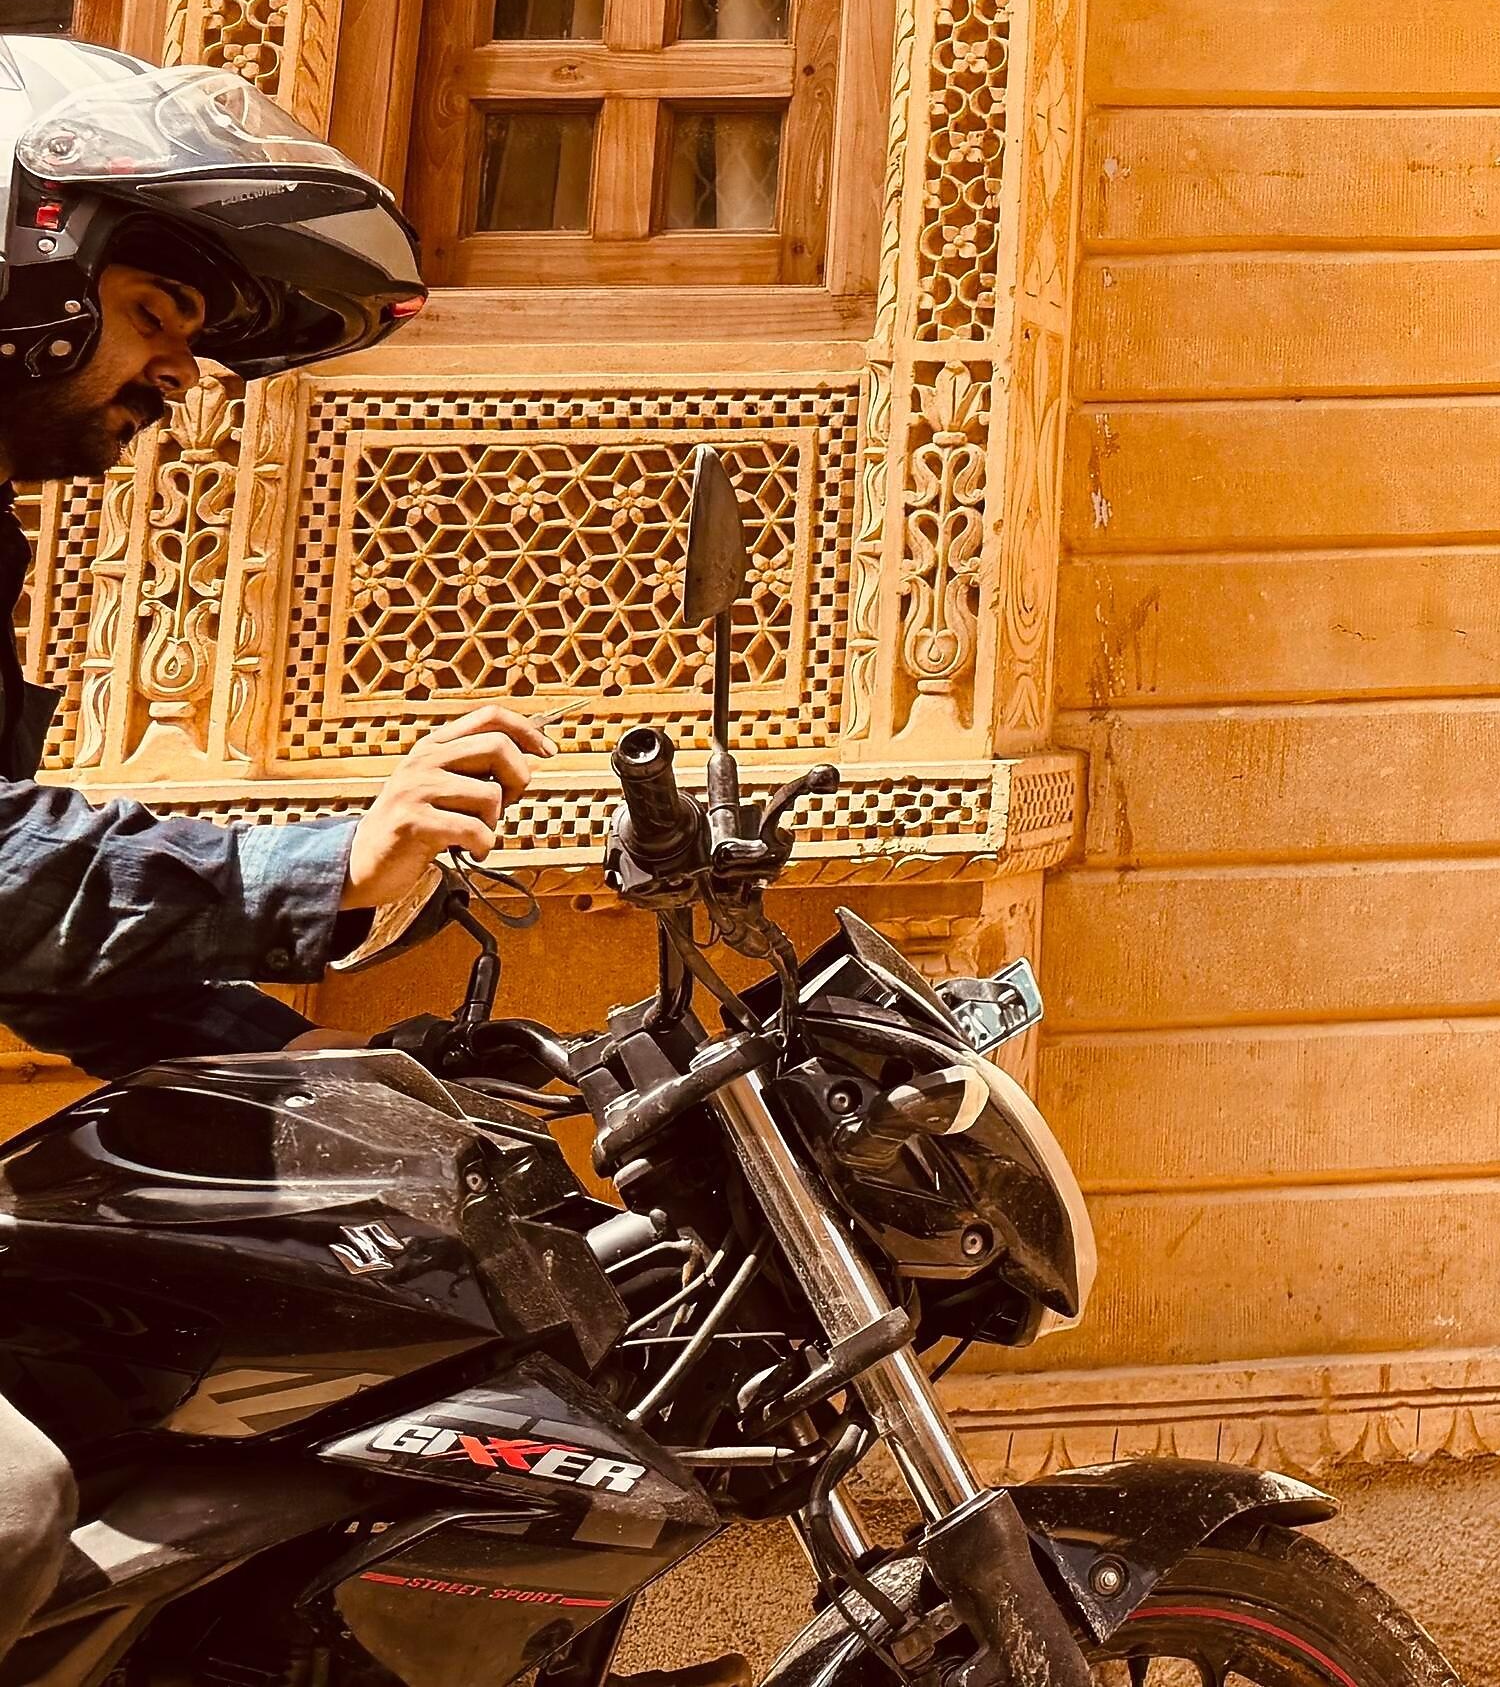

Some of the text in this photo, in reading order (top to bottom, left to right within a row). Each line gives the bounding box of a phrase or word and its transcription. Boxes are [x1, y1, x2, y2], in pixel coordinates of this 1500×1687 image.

[371, 1420, 647, 1494] GIXXER
[406, 1576, 564, 1605] STREET SPORT
